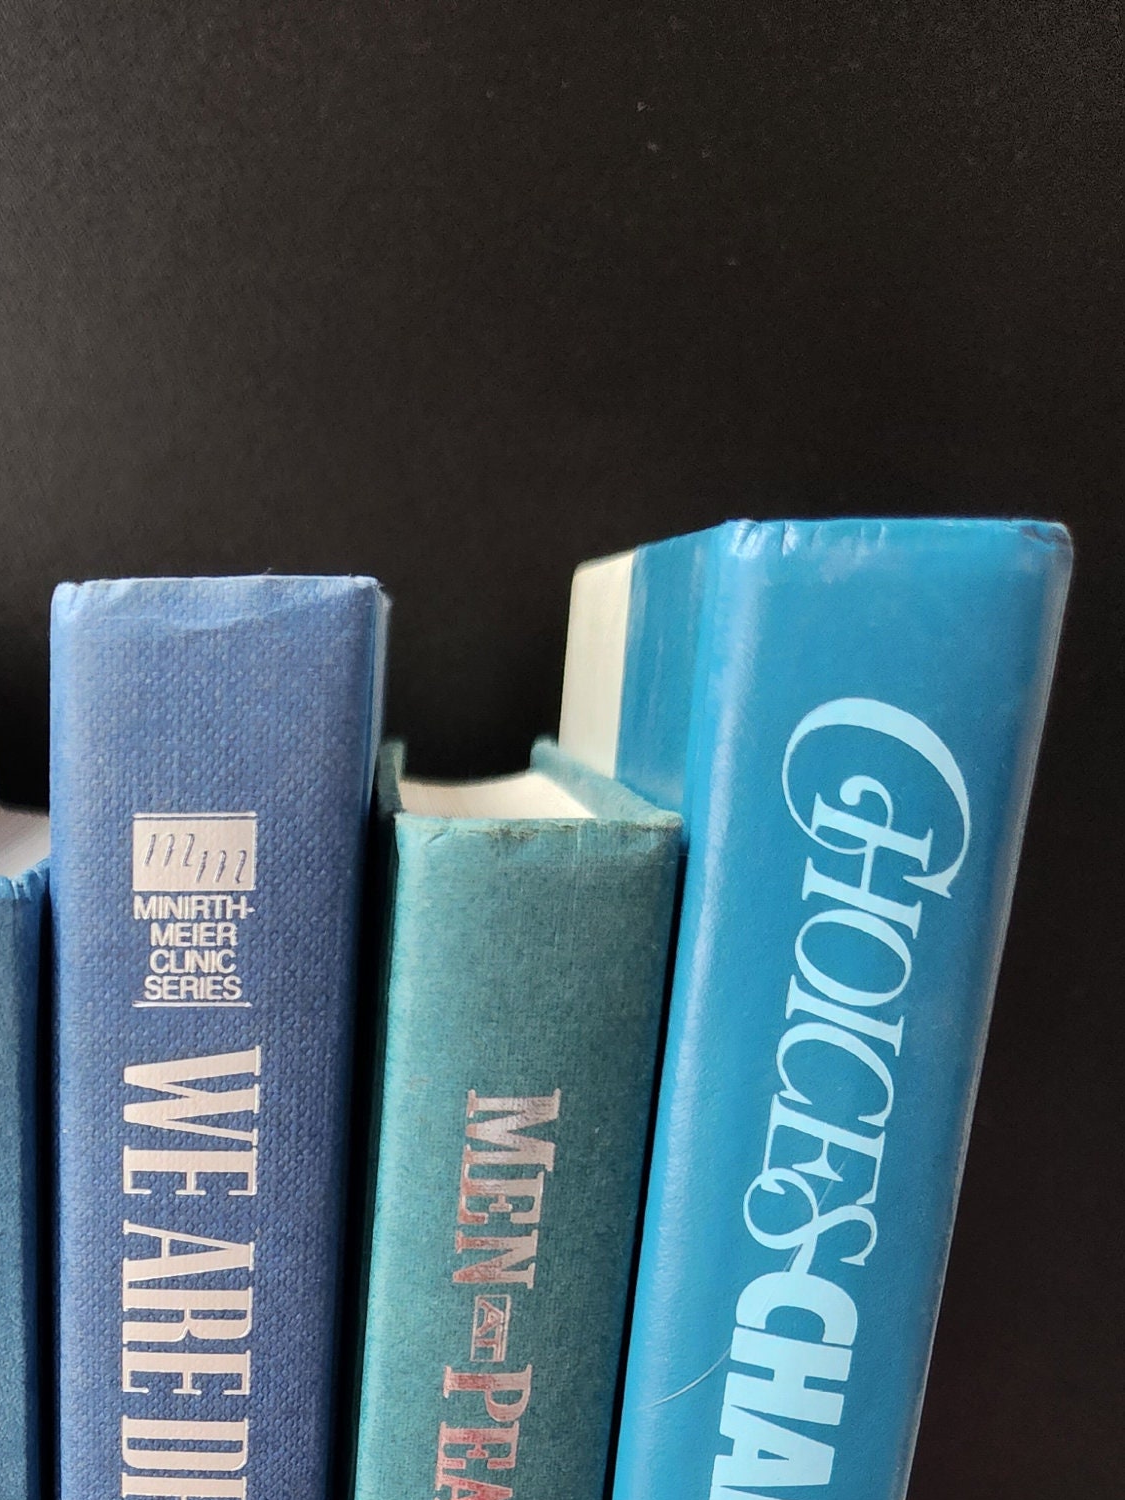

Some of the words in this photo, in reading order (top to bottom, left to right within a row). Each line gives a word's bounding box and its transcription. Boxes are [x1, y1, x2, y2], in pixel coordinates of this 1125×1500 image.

[133, 895, 256, 920] MINIRTH-
[150, 922, 238, 947] MEIER
[144, 975, 244, 1000] SERIES
[149, 949, 237, 974] CLINIC
[743, 697, 971, 1266] CHOICES
[121, 1045, 263, 1198] WE
[453, 1087, 562, 1289] MEN
[120, 1217, 255, 1397] ARE
